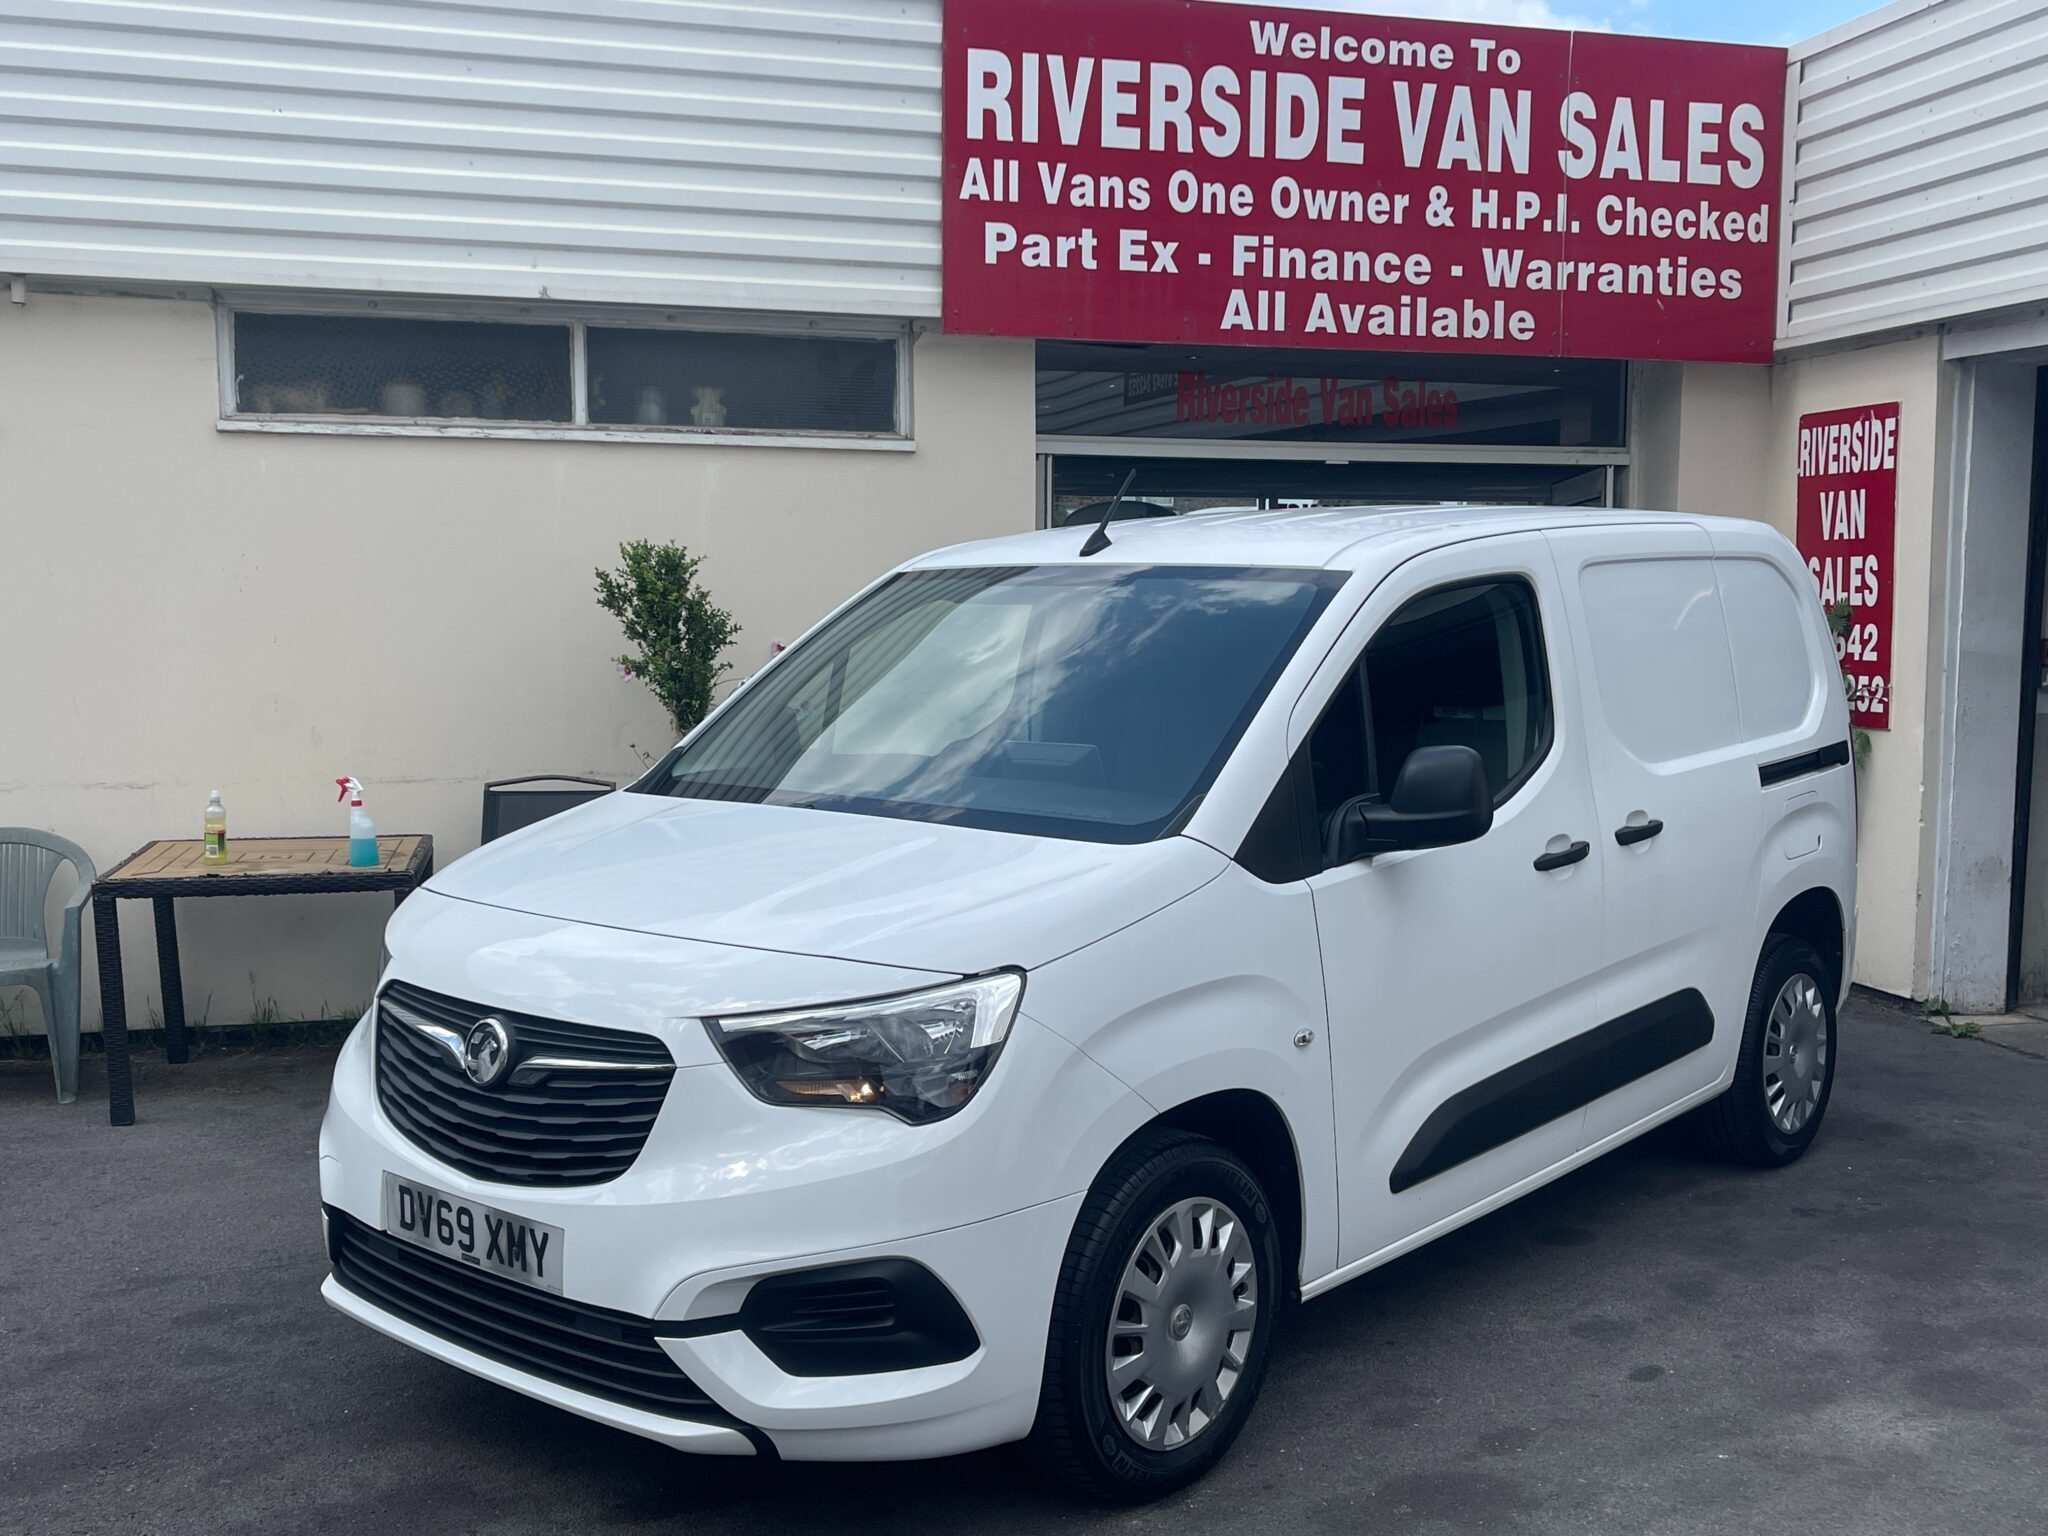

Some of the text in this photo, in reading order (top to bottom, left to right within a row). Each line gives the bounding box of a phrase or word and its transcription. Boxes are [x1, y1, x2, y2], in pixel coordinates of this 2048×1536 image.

[1249, 20, 1521, 75] Welcome To
[966, 47, 1765, 189] RIVERSIDE VAN SALES
[959, 157, 1769, 243] All Vans One Owner & H.P.I. Checked
[984, 221, 1742, 300] Part Ex Finance Warranties
[1219, 288, 1536, 341] All Available
[1177, 370, 1310, 425] Riverside
[1320, 372, 1372, 426] Van
[1382, 376, 1458, 428] Sales
[1799, 417, 1897, 478] RIVERSIDE
[1819, 488, 1866, 541] VAN
[1808, 554, 1879, 607] SALES
[398, 1184, 549, 1278] DV69 XMY
